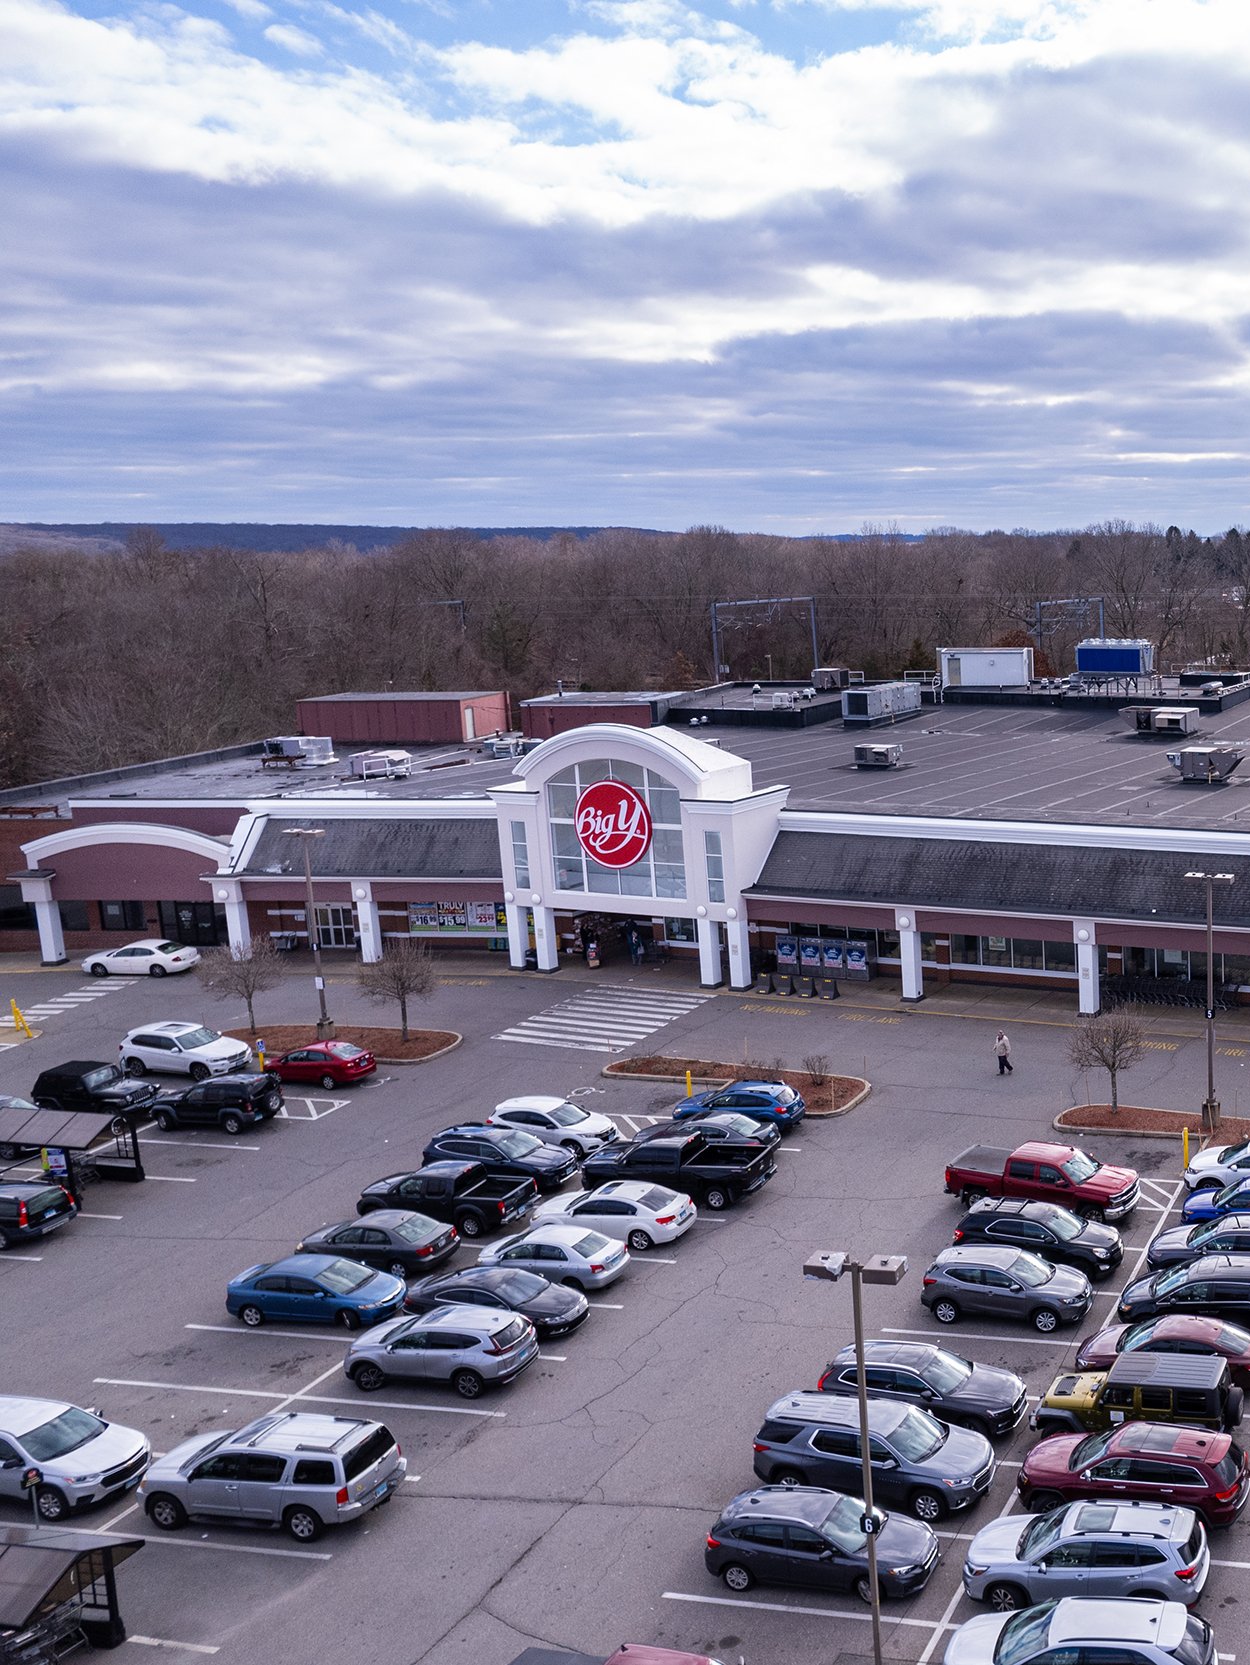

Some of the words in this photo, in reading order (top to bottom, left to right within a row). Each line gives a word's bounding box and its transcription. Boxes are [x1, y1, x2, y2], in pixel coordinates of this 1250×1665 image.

[578, 807, 616, 846] Big
[595, 799, 643, 854] Y
[438, 901, 464, 909] TRULY
[1207, 1010, 1212, 1018] 5
[1215, 1047, 1247, 1057] FIRE
[864, 1518, 873, 1533] 6
